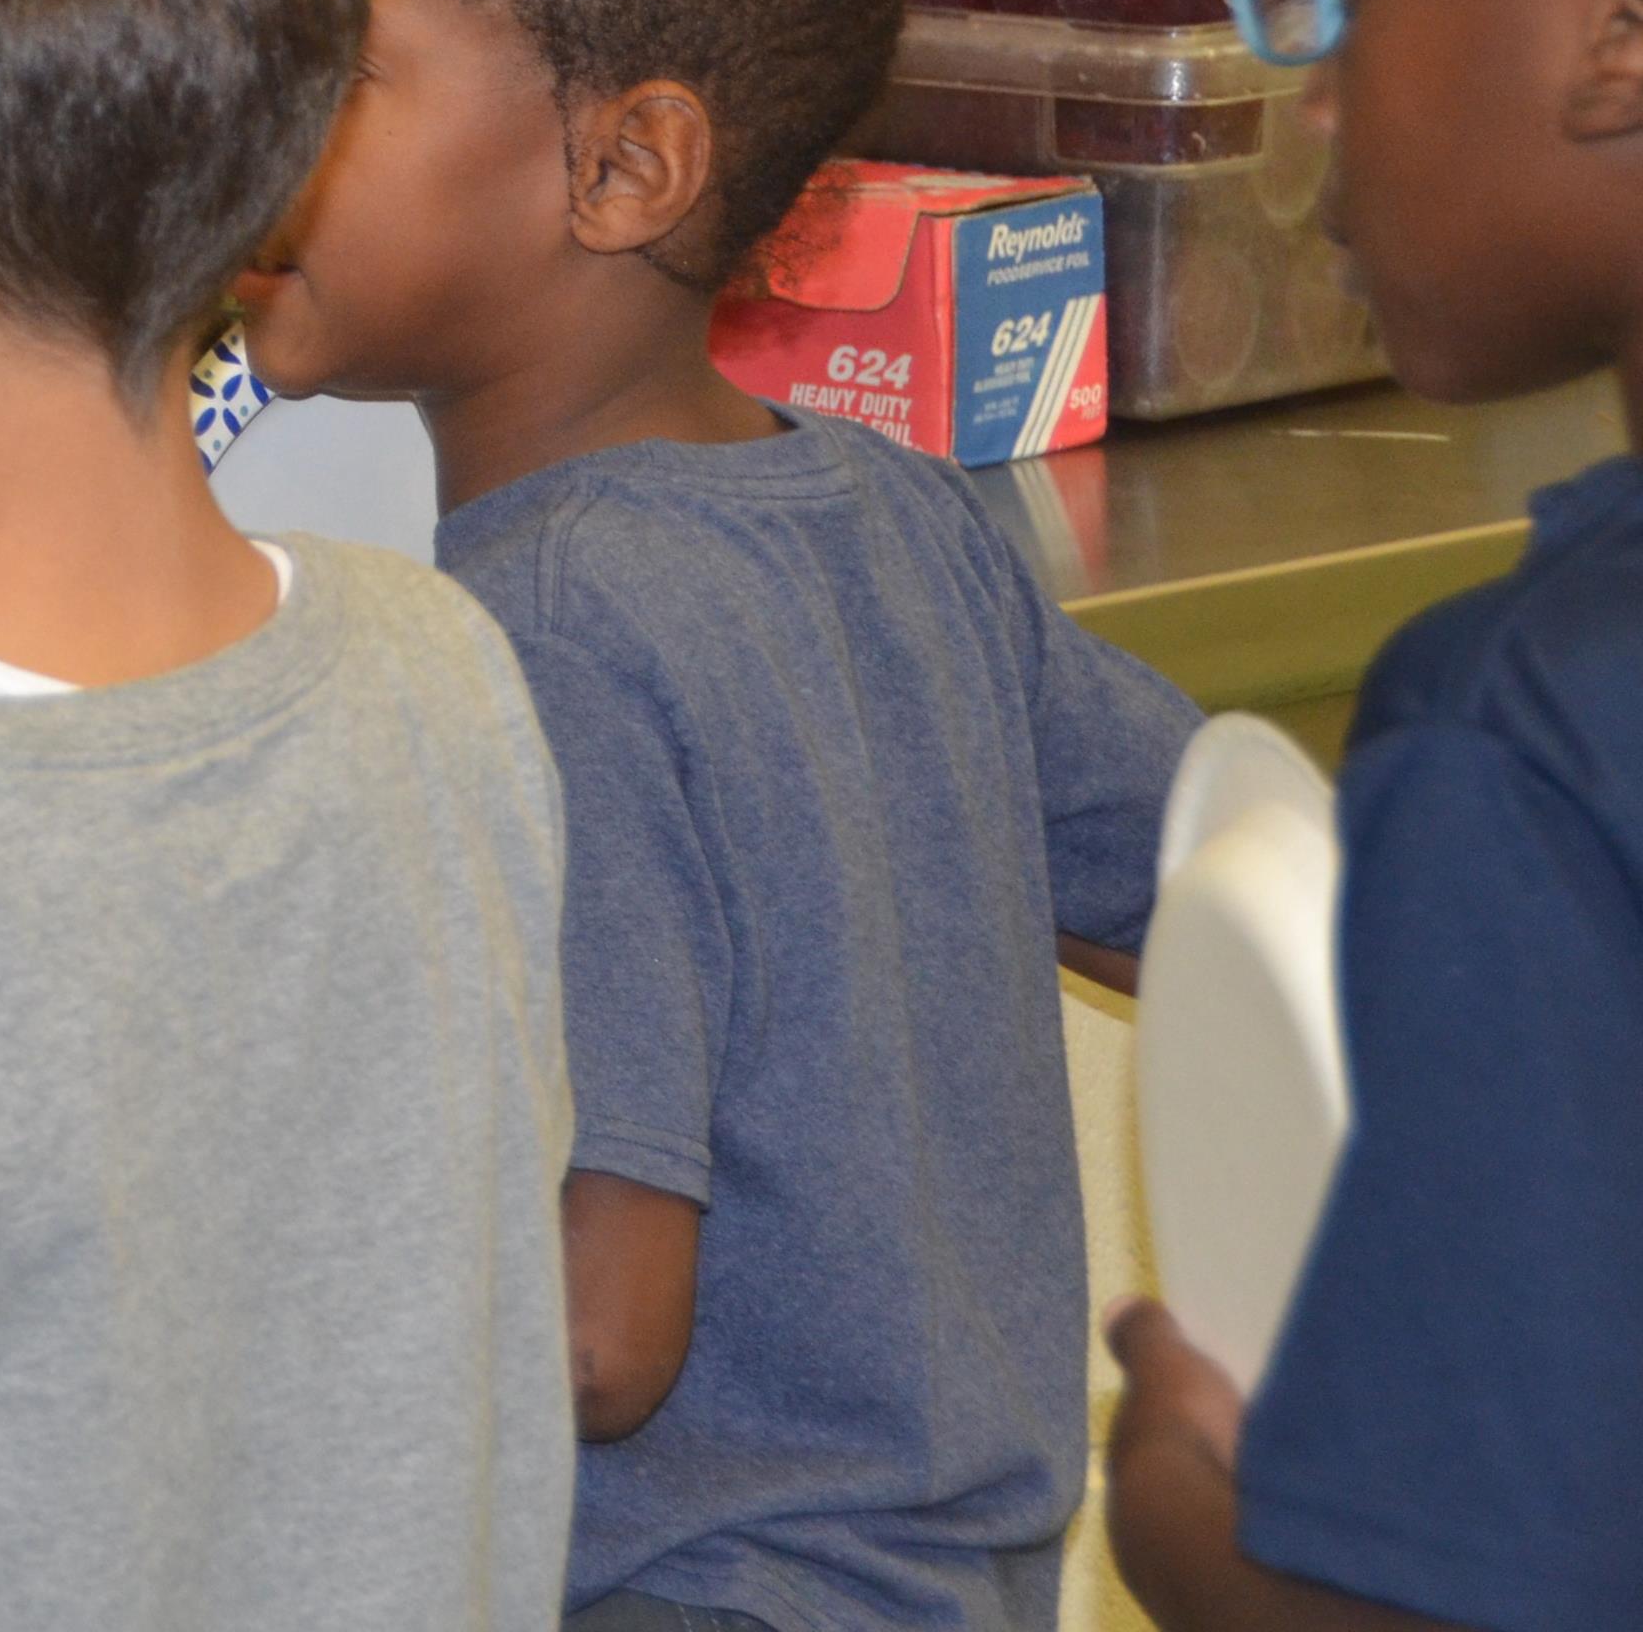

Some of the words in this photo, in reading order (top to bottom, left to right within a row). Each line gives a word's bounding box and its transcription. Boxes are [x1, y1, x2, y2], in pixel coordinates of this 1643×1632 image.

[987, 212, 1085, 263] Reynolds
[986, 254, 1065, 286] FOODSERVICE
[1066, 250, 1091, 270] FOIL
[990, 309, 1053, 357] 624
[827, 344, 913, 390] 624
[789, 383, 857, 414] HEAVY
[859, 391, 913, 421] DUTY
[1070, 383, 1102, 410] 500
